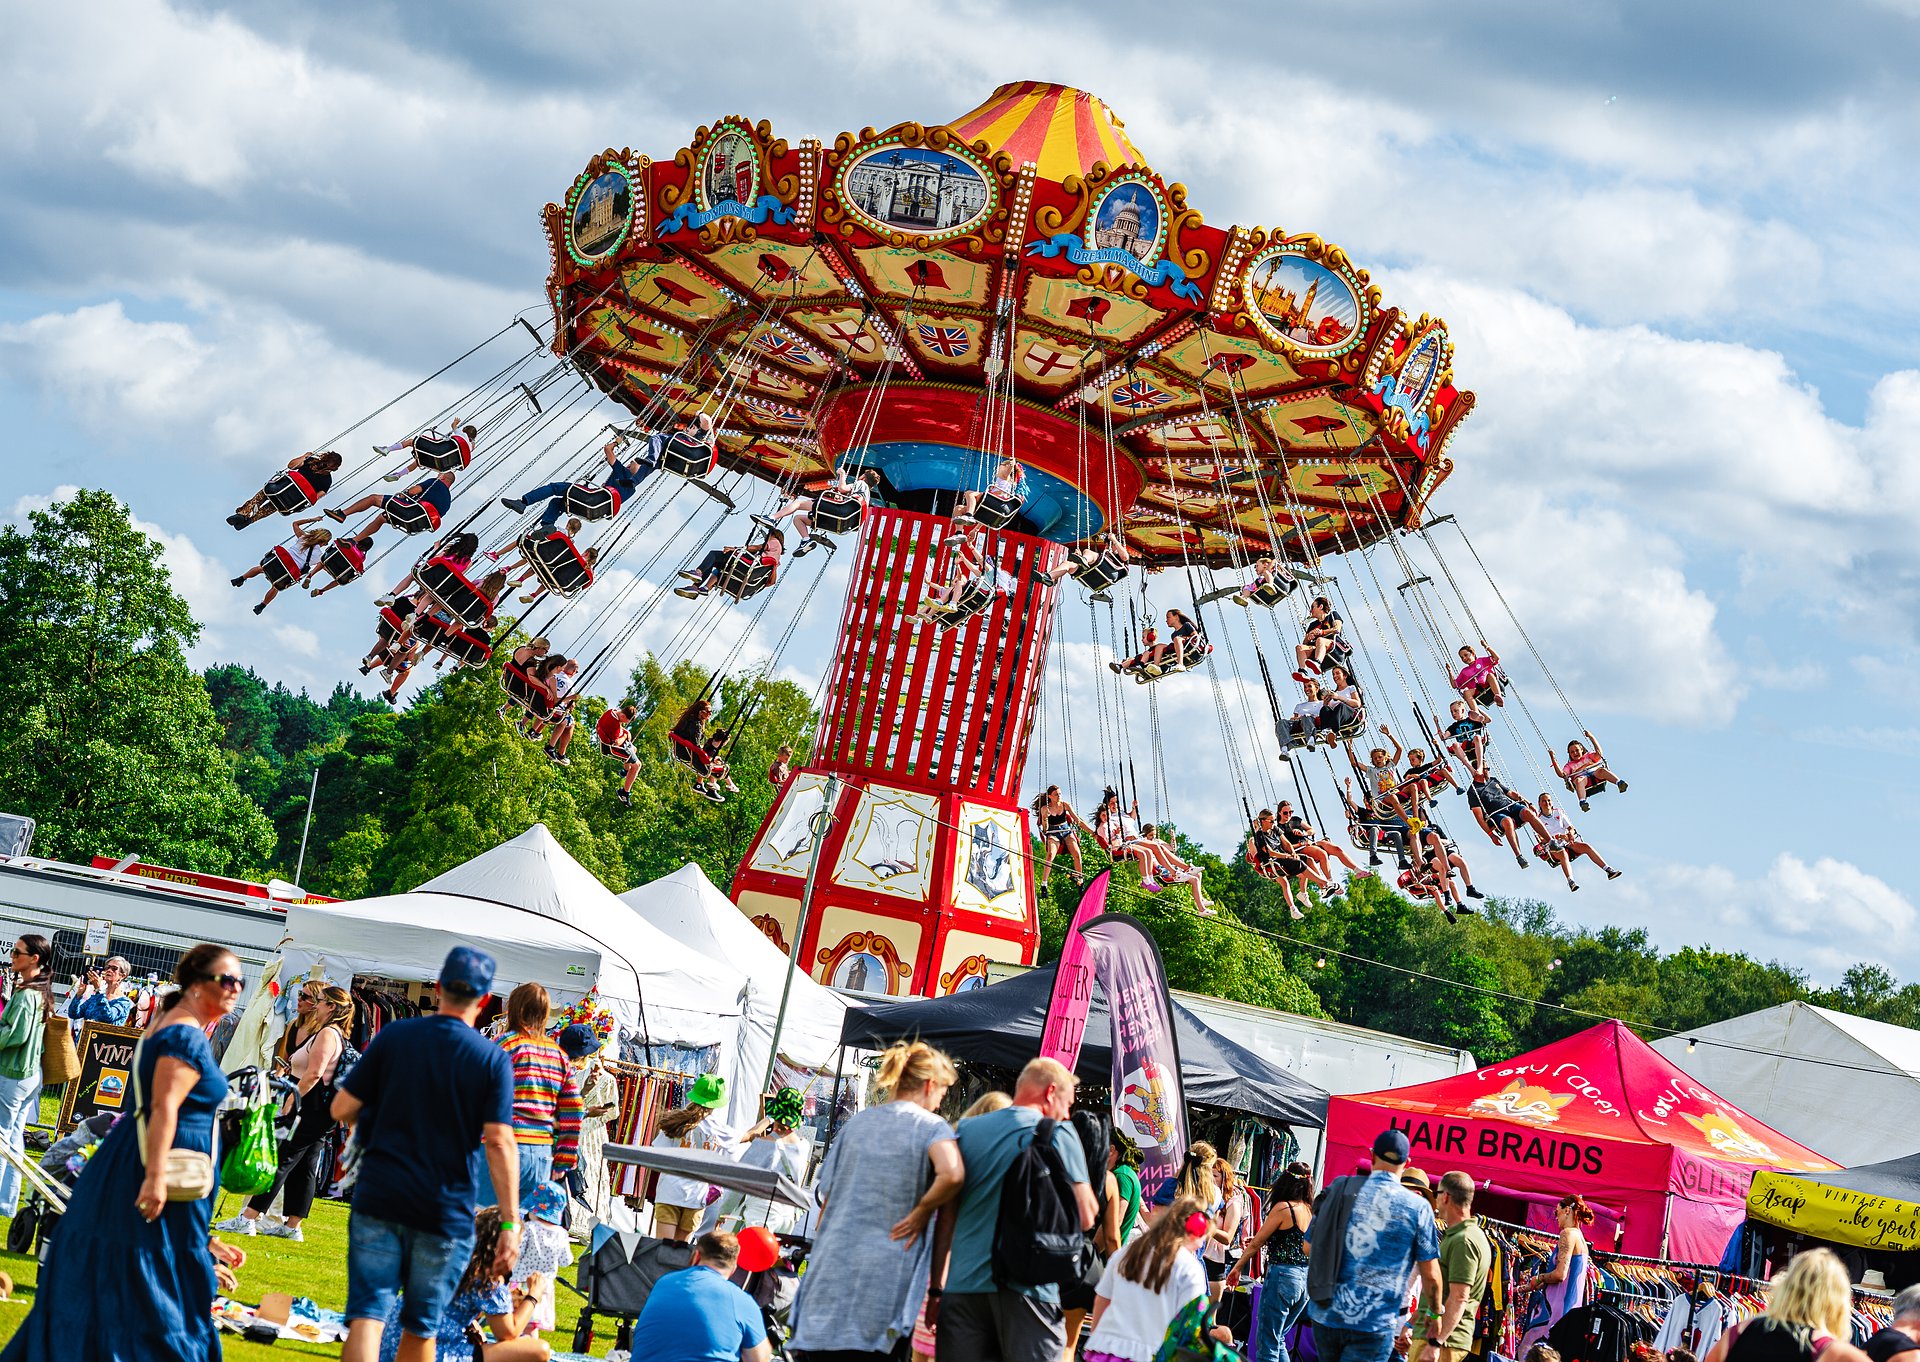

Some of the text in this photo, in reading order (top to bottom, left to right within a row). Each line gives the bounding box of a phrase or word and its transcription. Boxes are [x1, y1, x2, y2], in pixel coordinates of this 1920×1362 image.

[1073, 248, 1160, 282] DREAM MACHINE
[1119, 1010, 1160, 1040] HENNA
[1390, 1116, 1604, 1175] HAIR BRAIDS
[1750, 1188, 1806, 1215] Asap
[1825, 1188, 1887, 1209] VINTAGE
[1894, 1204, 1901, 1212] &
